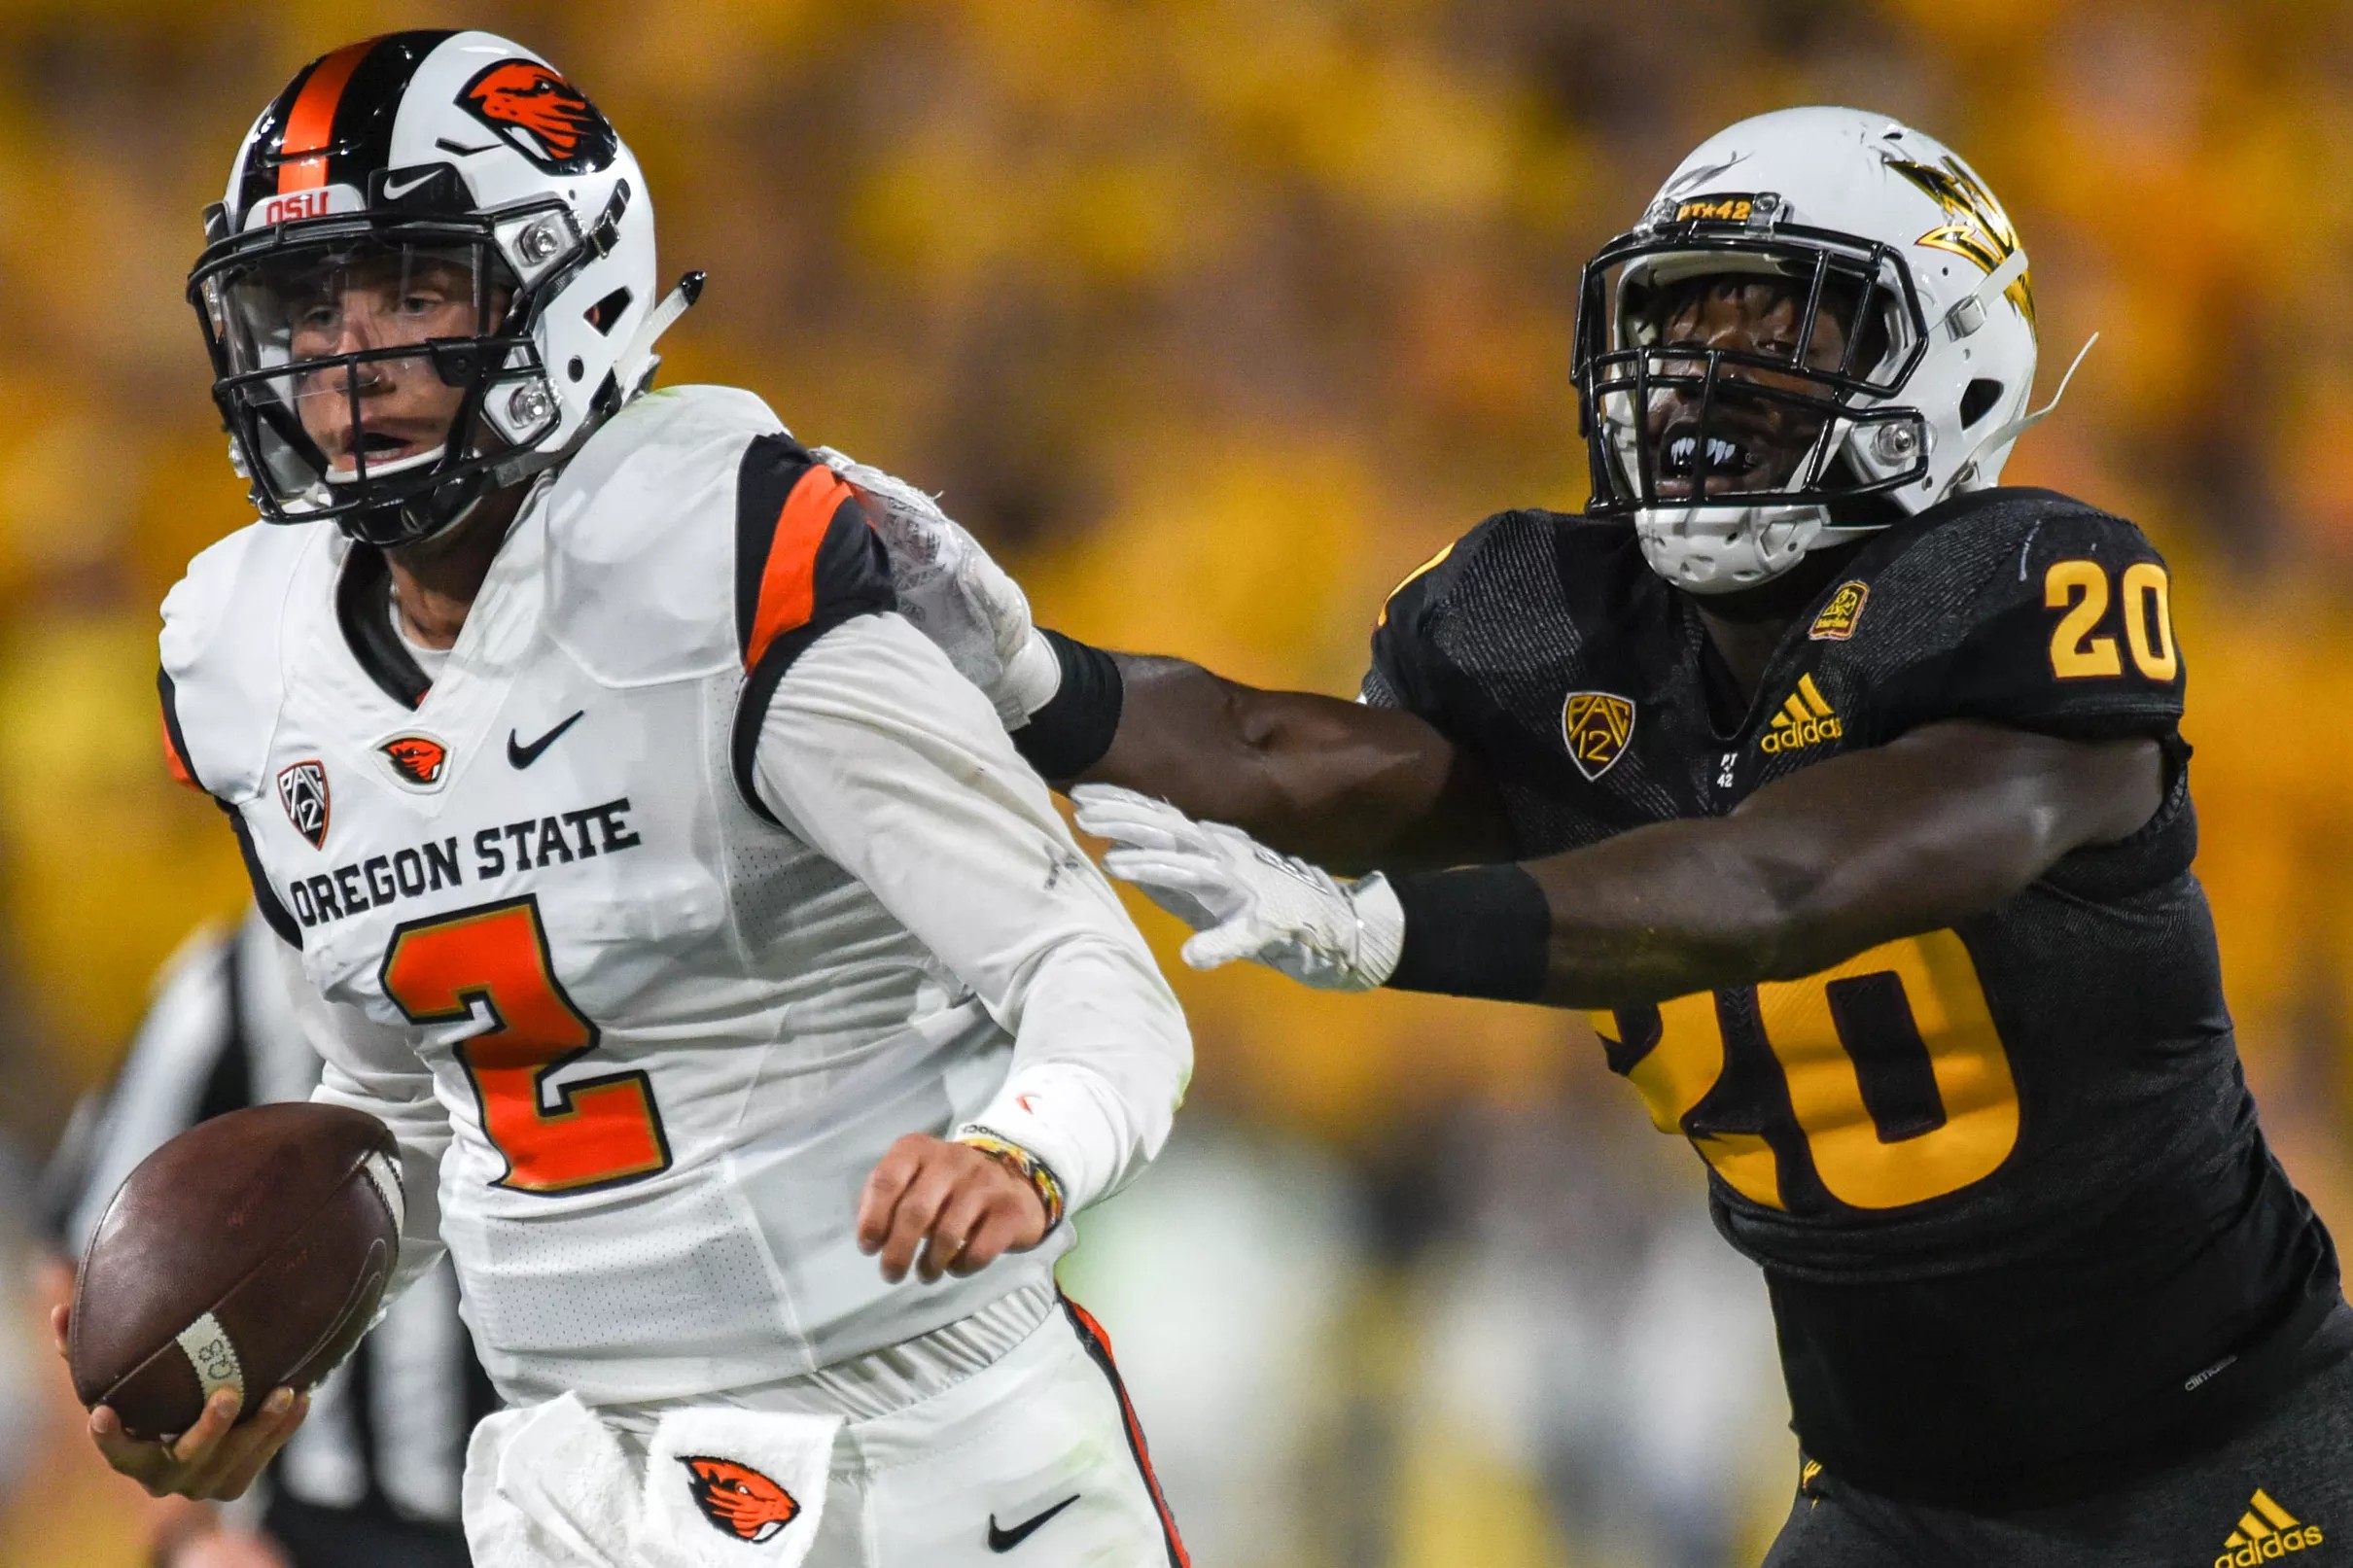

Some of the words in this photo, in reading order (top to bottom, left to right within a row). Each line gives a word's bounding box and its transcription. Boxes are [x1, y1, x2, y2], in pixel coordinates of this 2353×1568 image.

[265, 192, 329, 226] OSU
[2044, 559, 2178, 681] 20
[1567, 695, 1632, 749] PAC
[1761, 716, 1844, 753] adidas
[1578, 729, 1613, 762] 12
[1720, 752, 1738, 767] PT
[1716, 773, 1735, 788] 42
[296, 798, 323, 834] 12
[290, 836, 463, 928] OREGON
[474, 797, 642, 881] STATE
[377, 892, 673, 1198] 2
[2214, 1525, 2325, 1568] adidas
